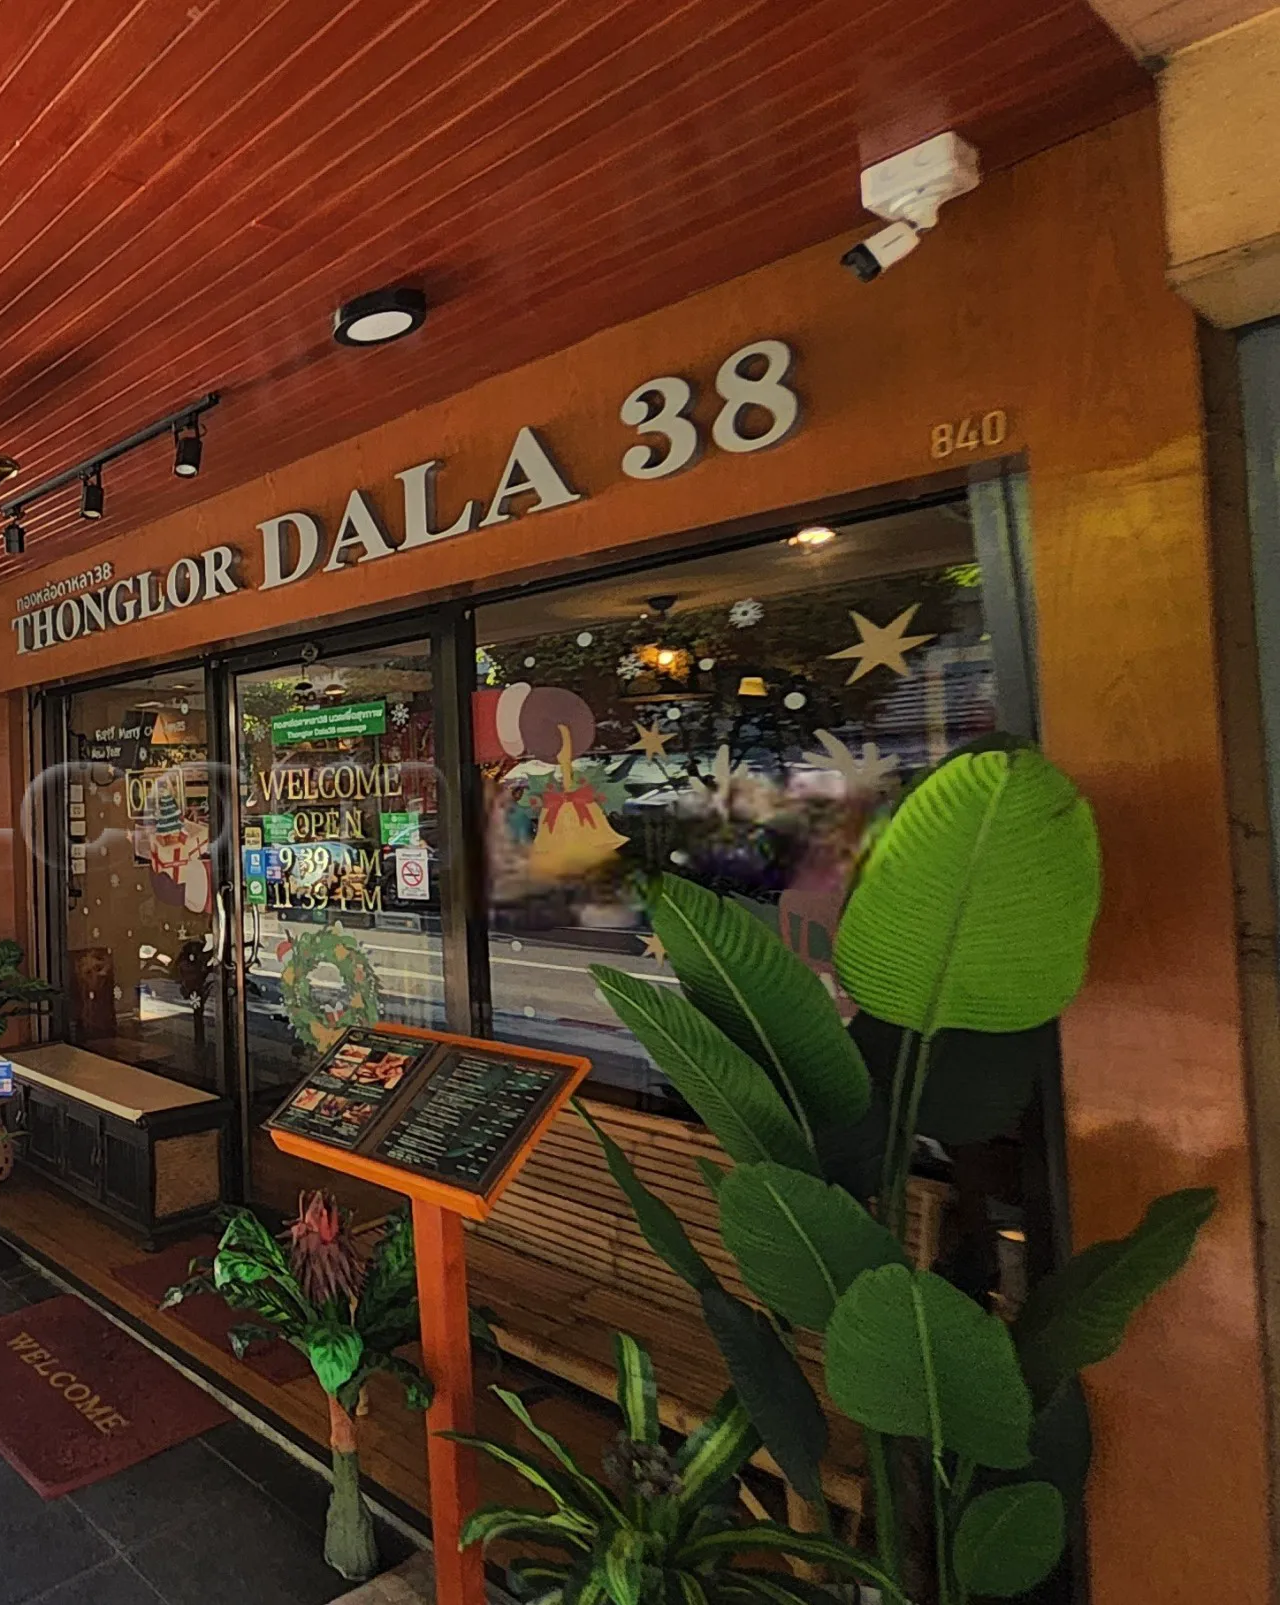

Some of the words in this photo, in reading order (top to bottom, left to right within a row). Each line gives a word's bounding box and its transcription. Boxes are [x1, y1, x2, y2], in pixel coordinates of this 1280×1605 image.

[930, 410, 1007, 460] 840
[12, 546, 238, 655] THONGLOR
[257, 426, 581, 591] DALA
[620, 340, 798, 480] 38
[258, 763, 402, 801] WELCOME
[293, 810, 365, 839] OPEN
[7, 1332, 130, 1435] WELCOME
